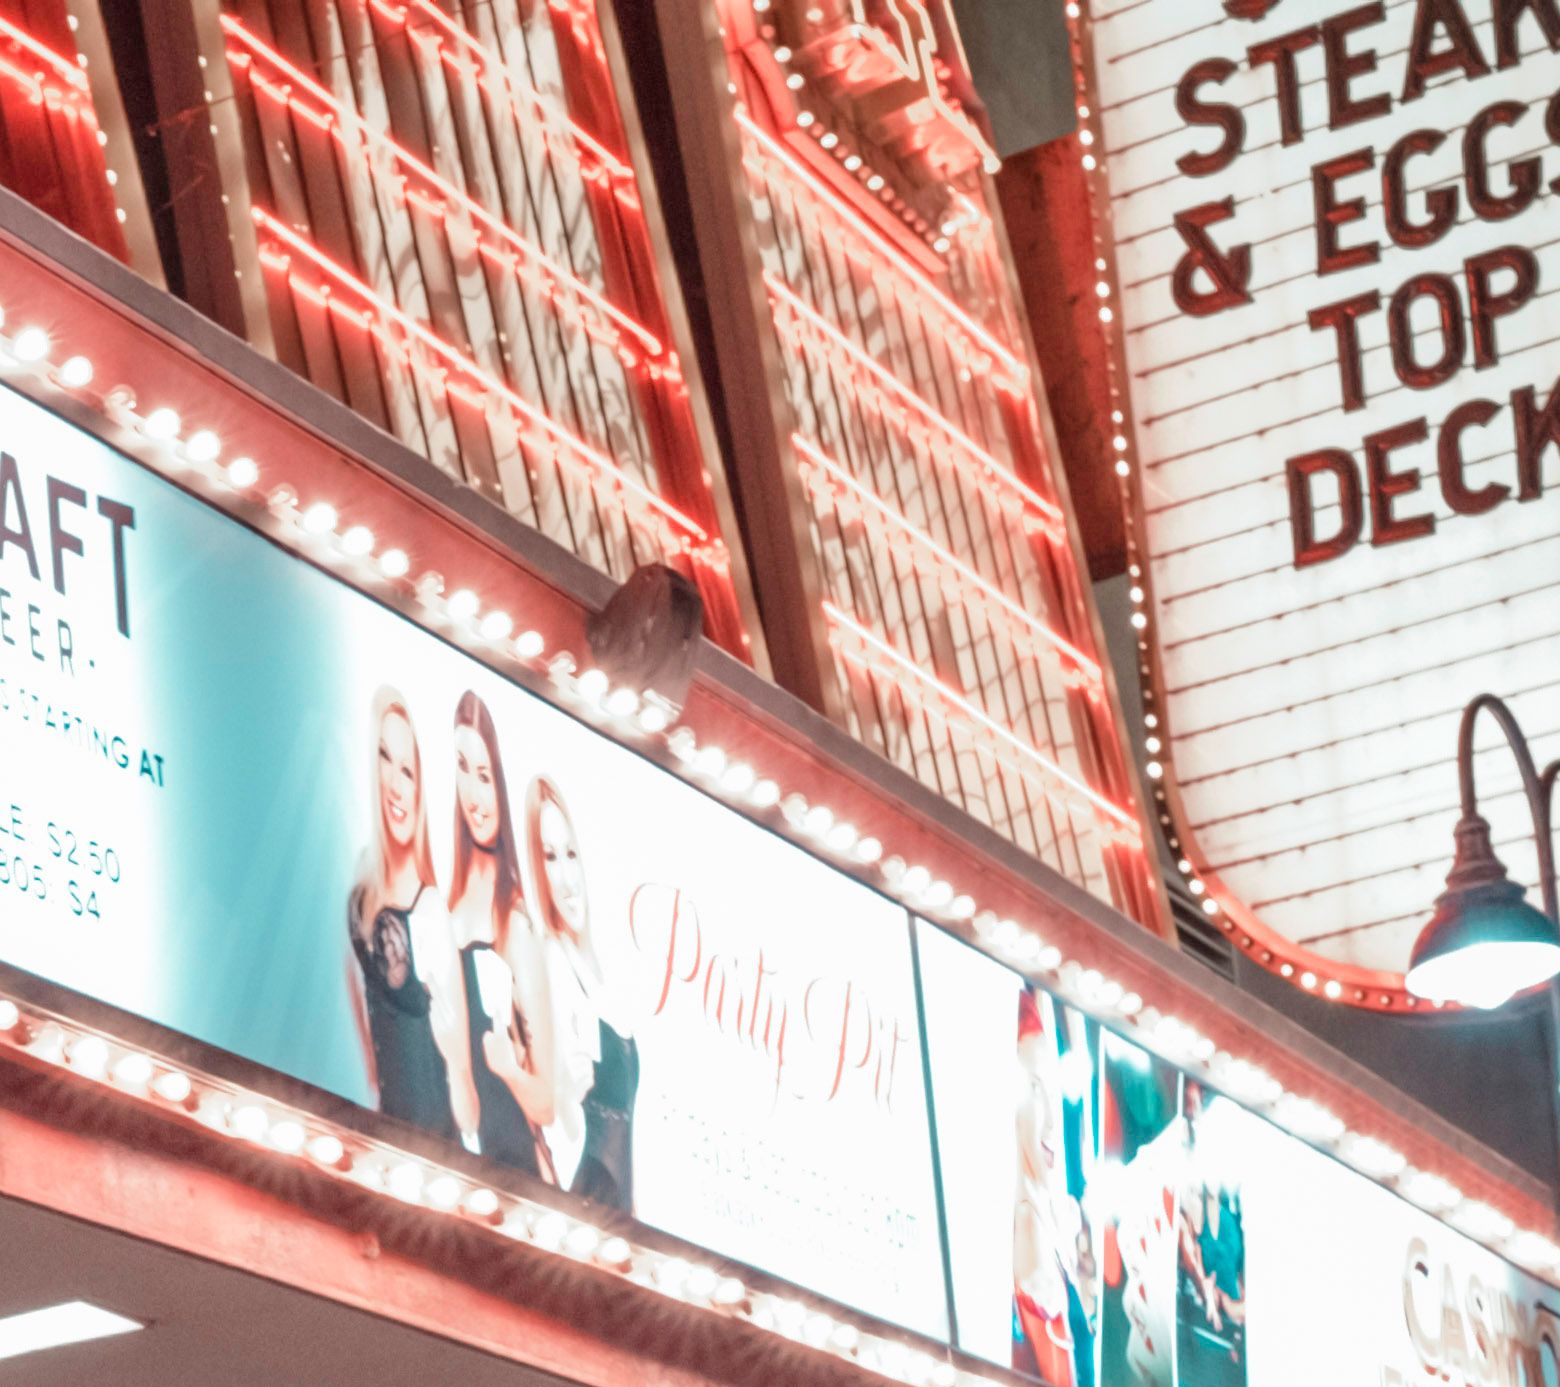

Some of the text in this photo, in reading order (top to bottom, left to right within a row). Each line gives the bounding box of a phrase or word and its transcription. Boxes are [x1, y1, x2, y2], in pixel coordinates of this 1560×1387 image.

[1171, 196, 1255, 318] &
[1308, 245, 1540, 412] TOP
[139, 748, 164, 787] AT
